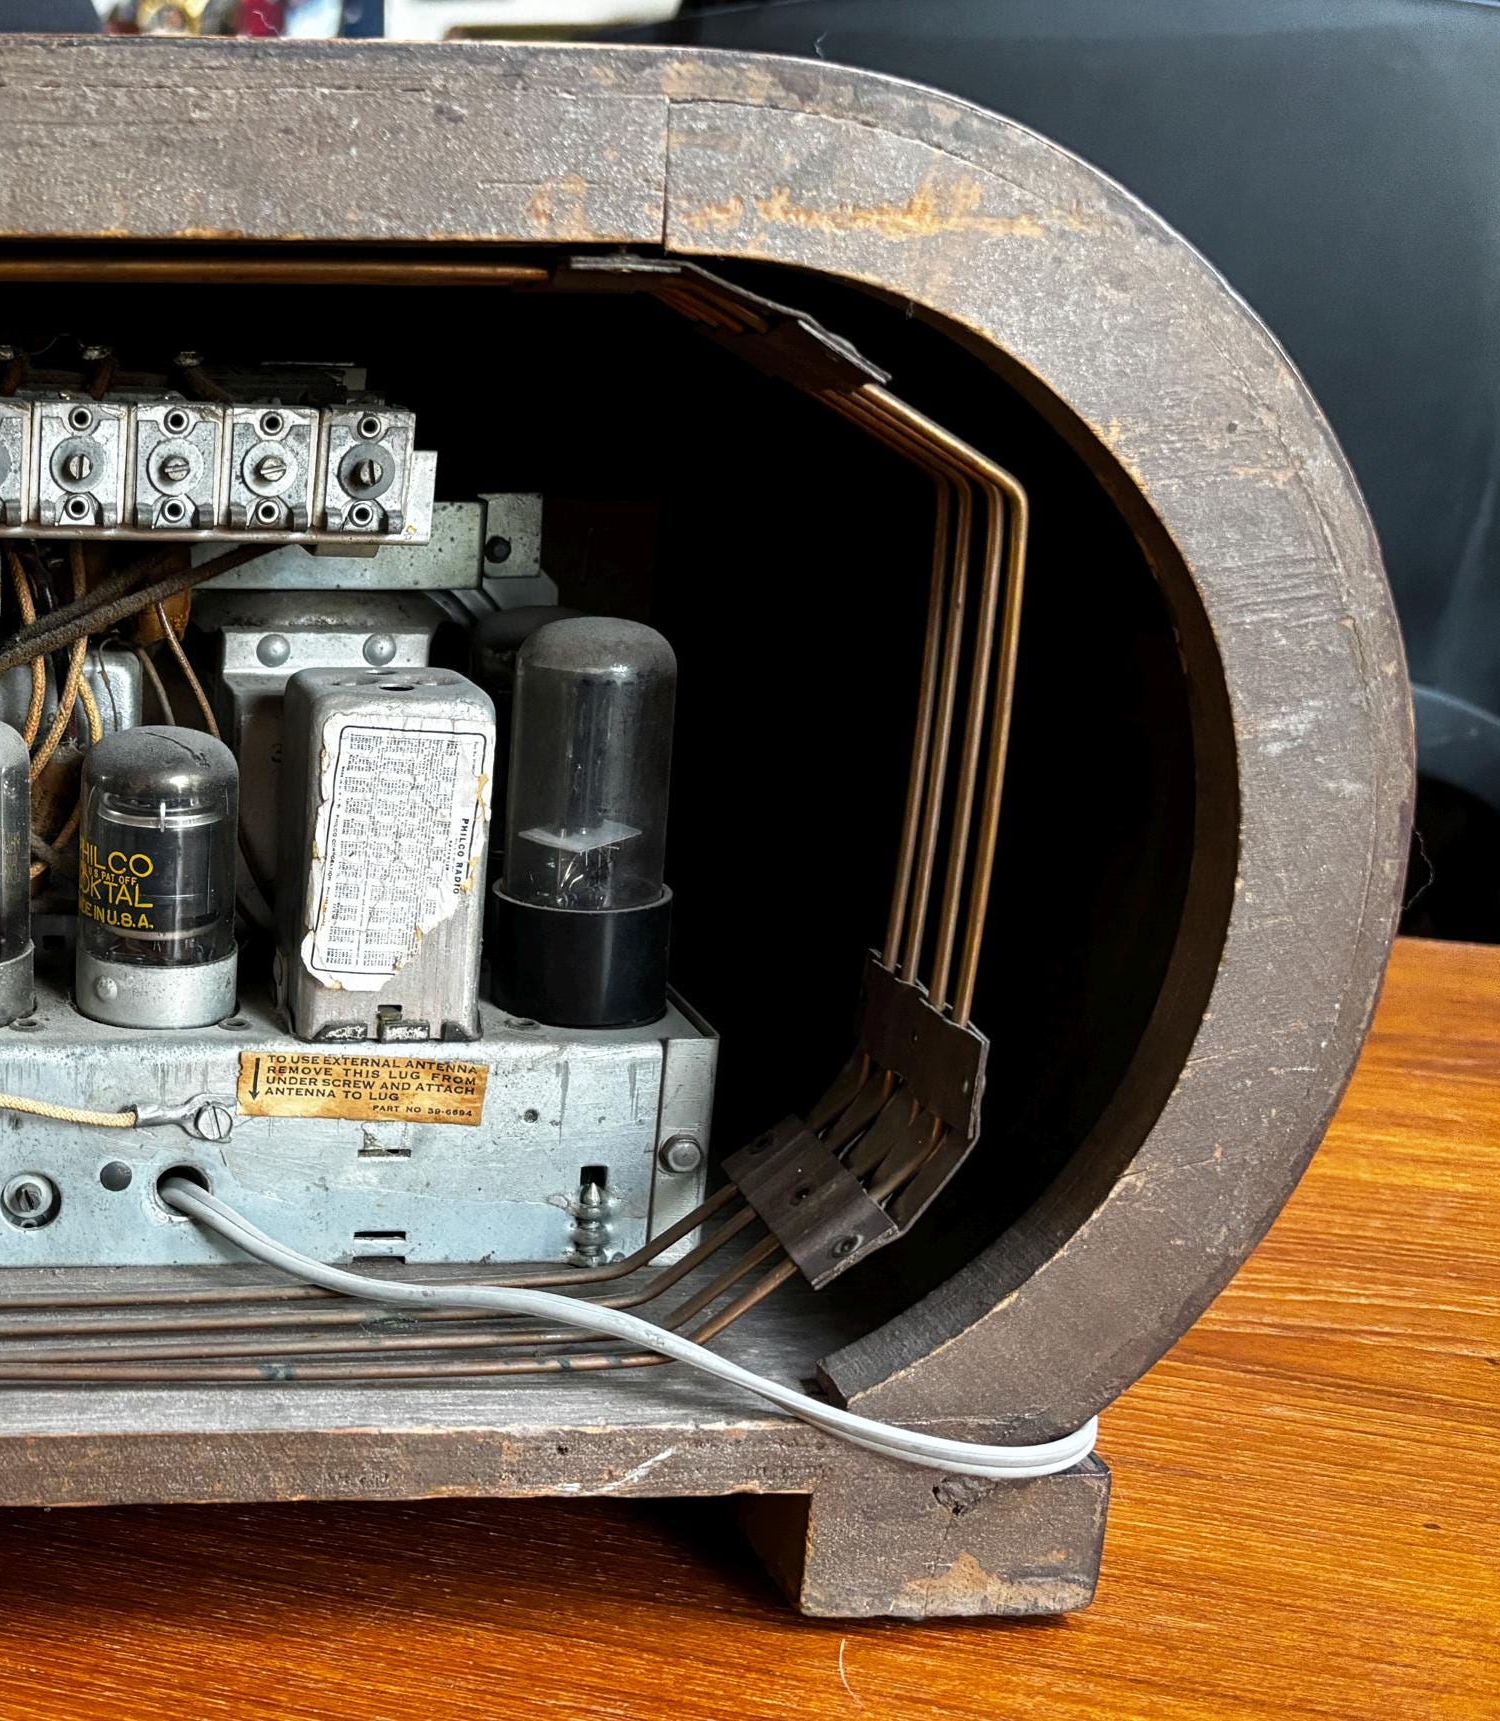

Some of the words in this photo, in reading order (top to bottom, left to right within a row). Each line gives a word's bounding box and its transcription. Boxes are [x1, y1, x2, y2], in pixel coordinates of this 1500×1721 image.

[456, 818, 470, 858] PHILCO
[452, 862, 464, 895] RADIO
[93, 905, 105, 924] IN
[268, 1054, 286, 1064] TO
[290, 1055, 320, 1065] USE
[323, 1056, 397, 1068] EXTERNAL
[405, 1059, 477, 1074] ANTENNA
[267, 1066, 333, 1076] REMOVE
[344, 1069, 380, 1078] THIS
[388, 1071, 421, 1080] LUG
[431, 1073, 476, 1085] FROM
[264, 1087, 336, 1098] ANTENNA
[343, 1090, 363, 1099] TO
[369, 1092, 399, 1101] LUG
[266, 1076, 318, 1086] UNDER
[322, 1079, 375, 1089] SCREW
[380, 1081, 411, 1091] AND
[415, 1082, 475, 1095] ATTACH
